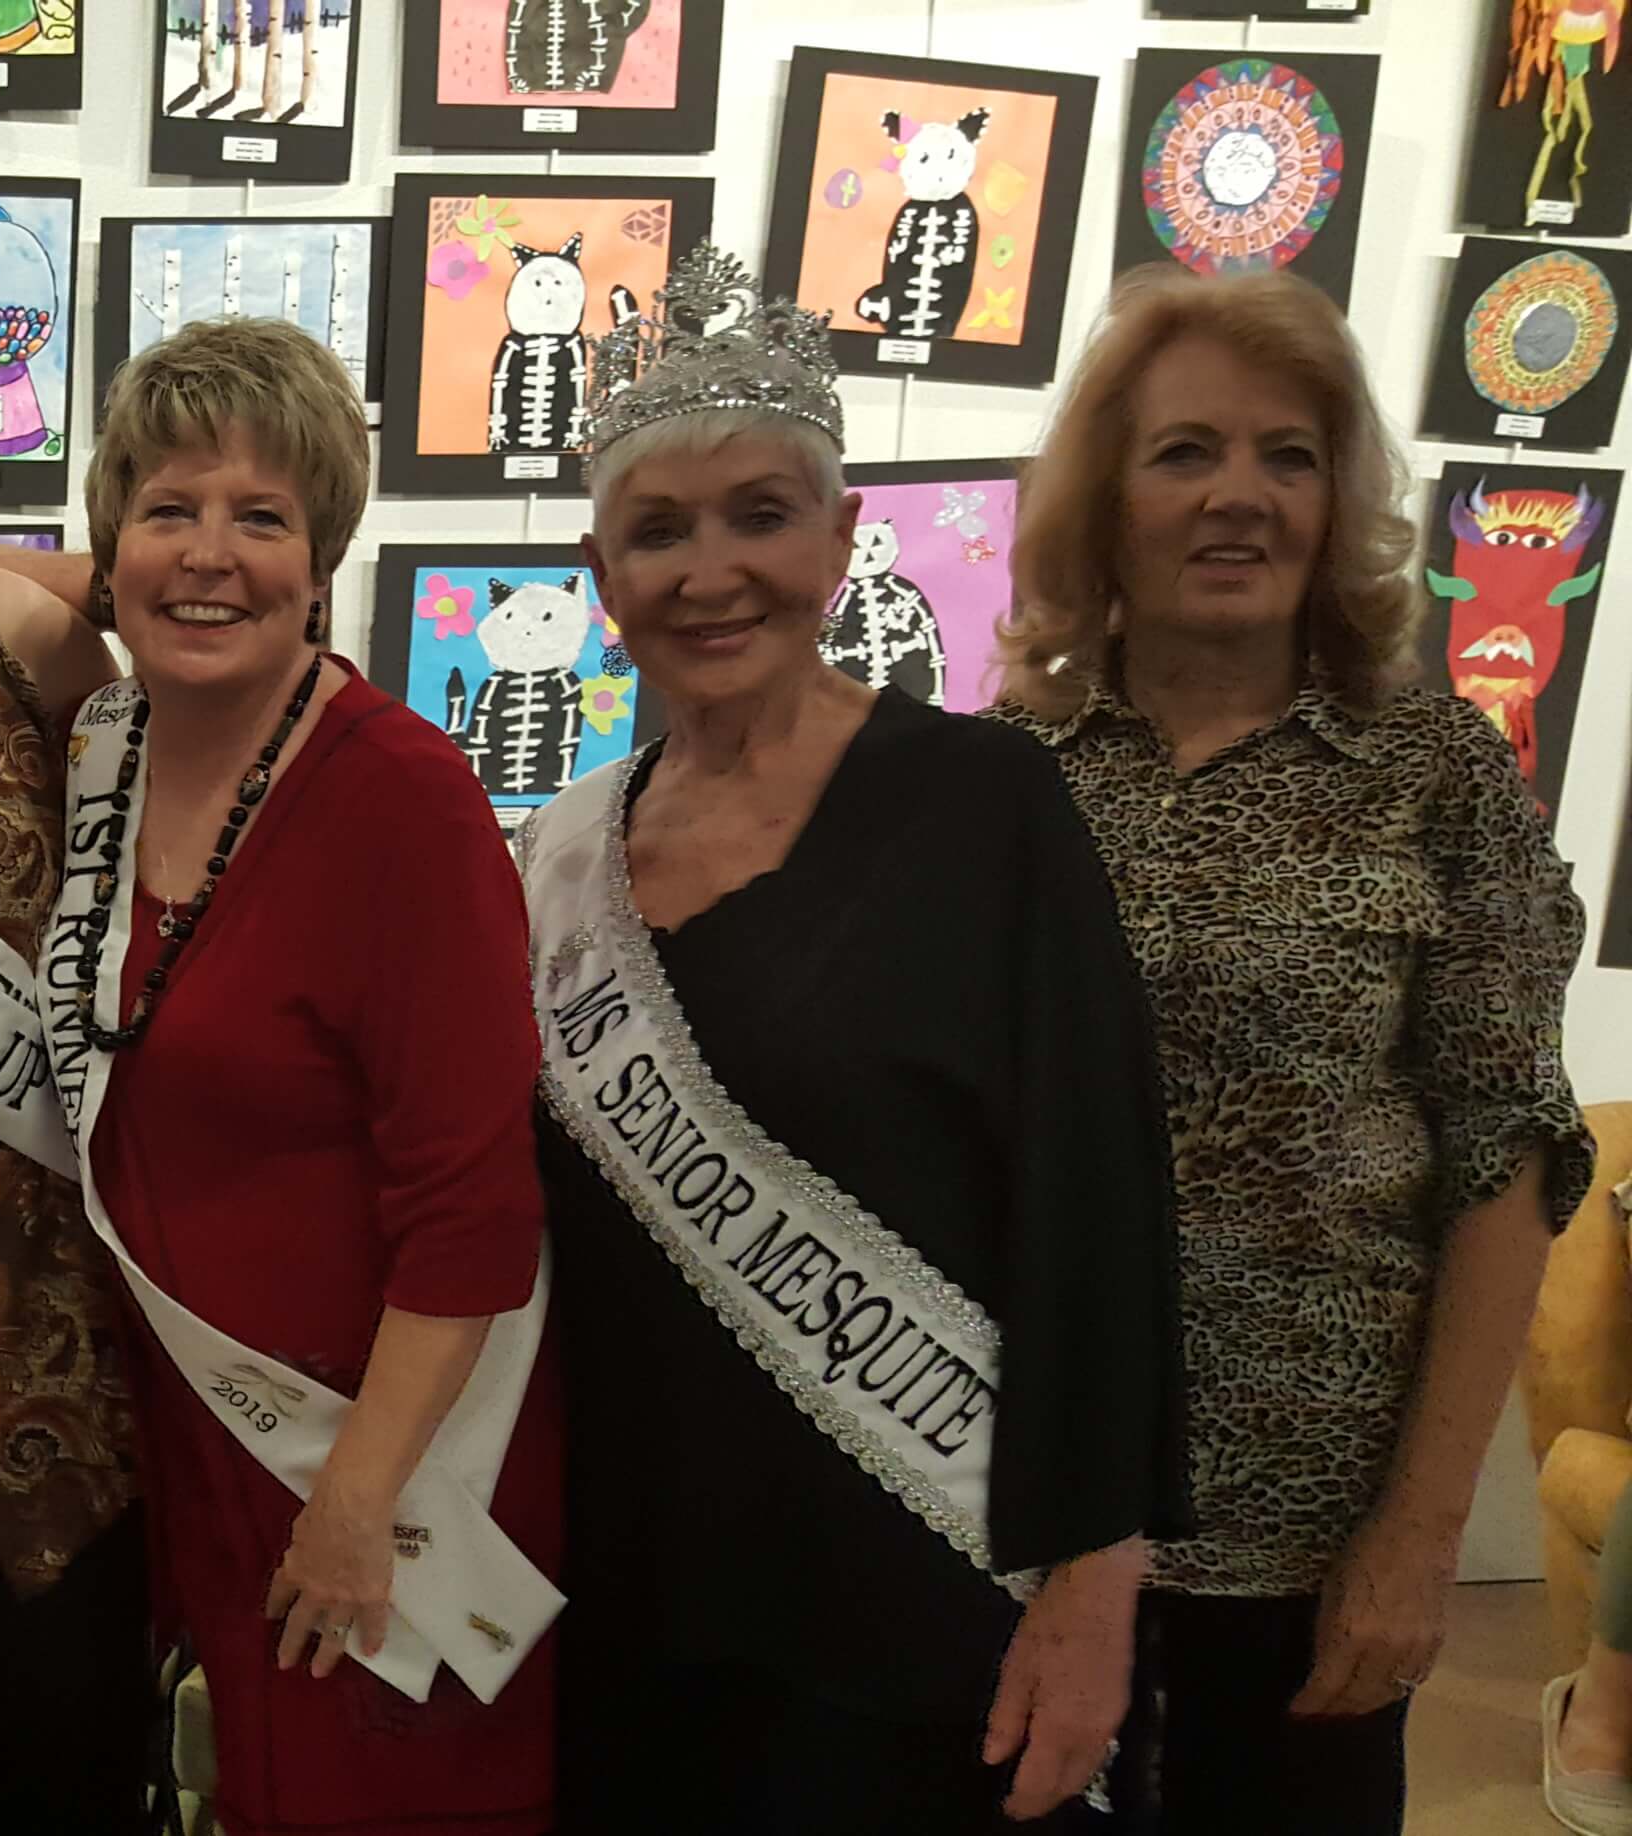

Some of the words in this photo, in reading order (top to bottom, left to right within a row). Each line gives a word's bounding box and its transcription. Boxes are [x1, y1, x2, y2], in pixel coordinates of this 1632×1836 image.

[551, 968, 630, 1073] MS.
[594, 1053, 756, 1244] SENIOR
[726, 1209, 1000, 1458] MESQUITE
[210, 1380, 277, 1432] 2019
